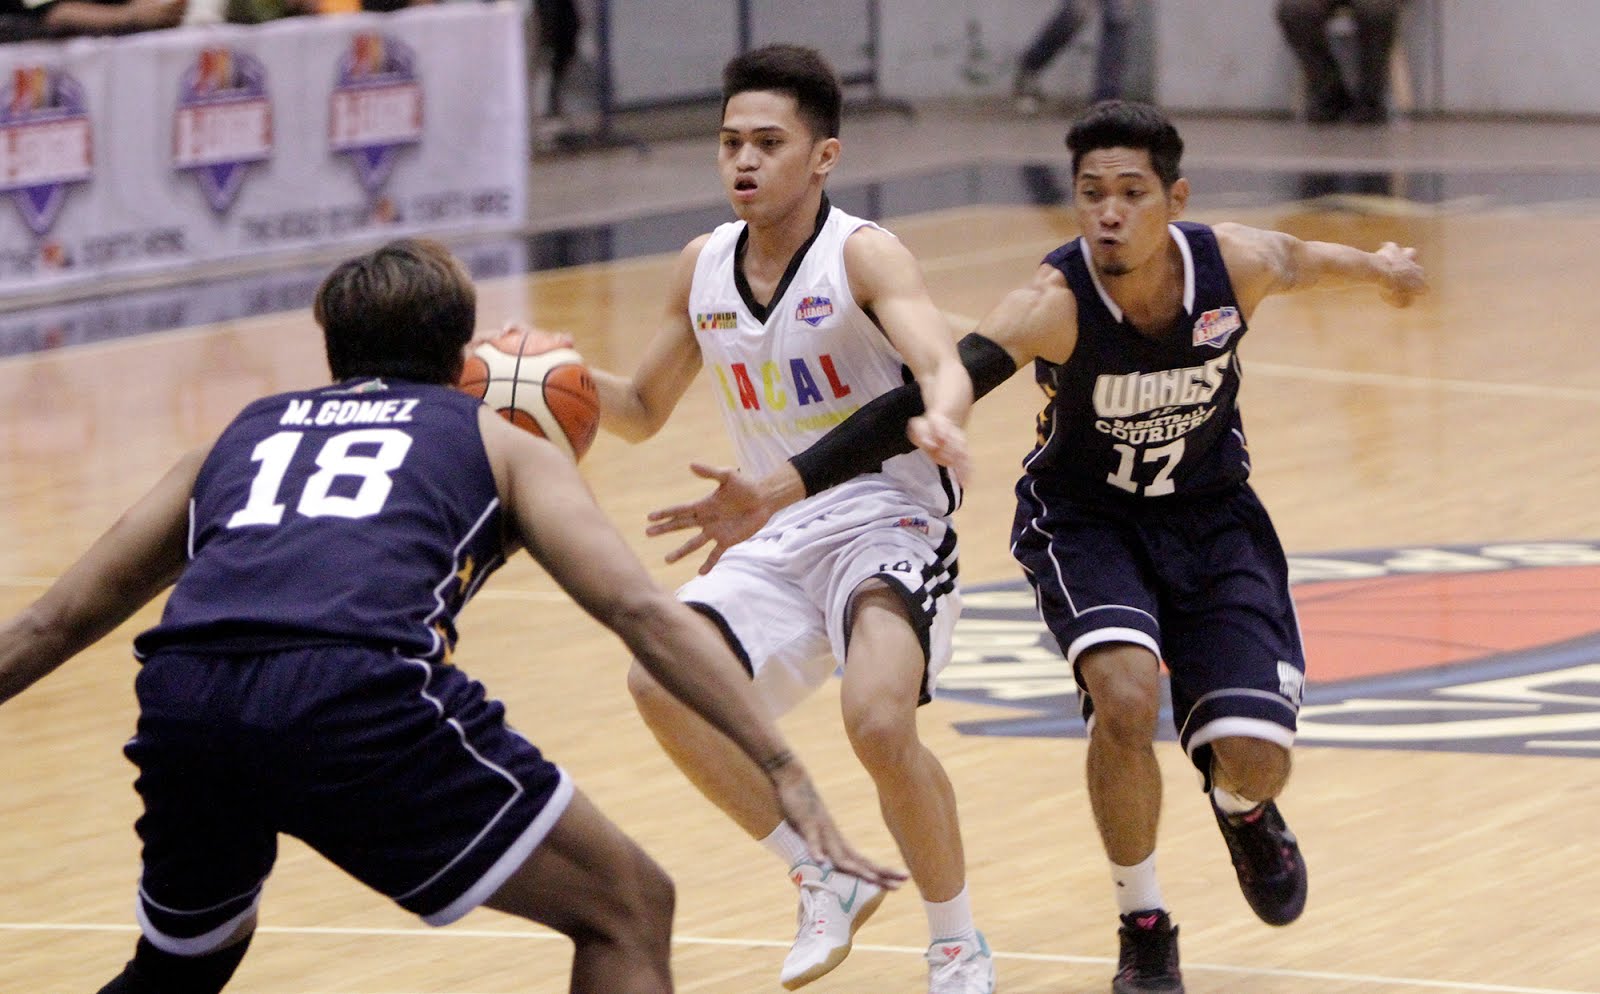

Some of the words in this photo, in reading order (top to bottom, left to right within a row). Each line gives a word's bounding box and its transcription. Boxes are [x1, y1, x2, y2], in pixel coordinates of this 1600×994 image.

[279, 398, 420, 426] M.GOMEZ
[1113, 405, 1206, 430] BASKETBALL
[226, 428, 413, 529] 18
[1106, 437, 1185, 497] 17
